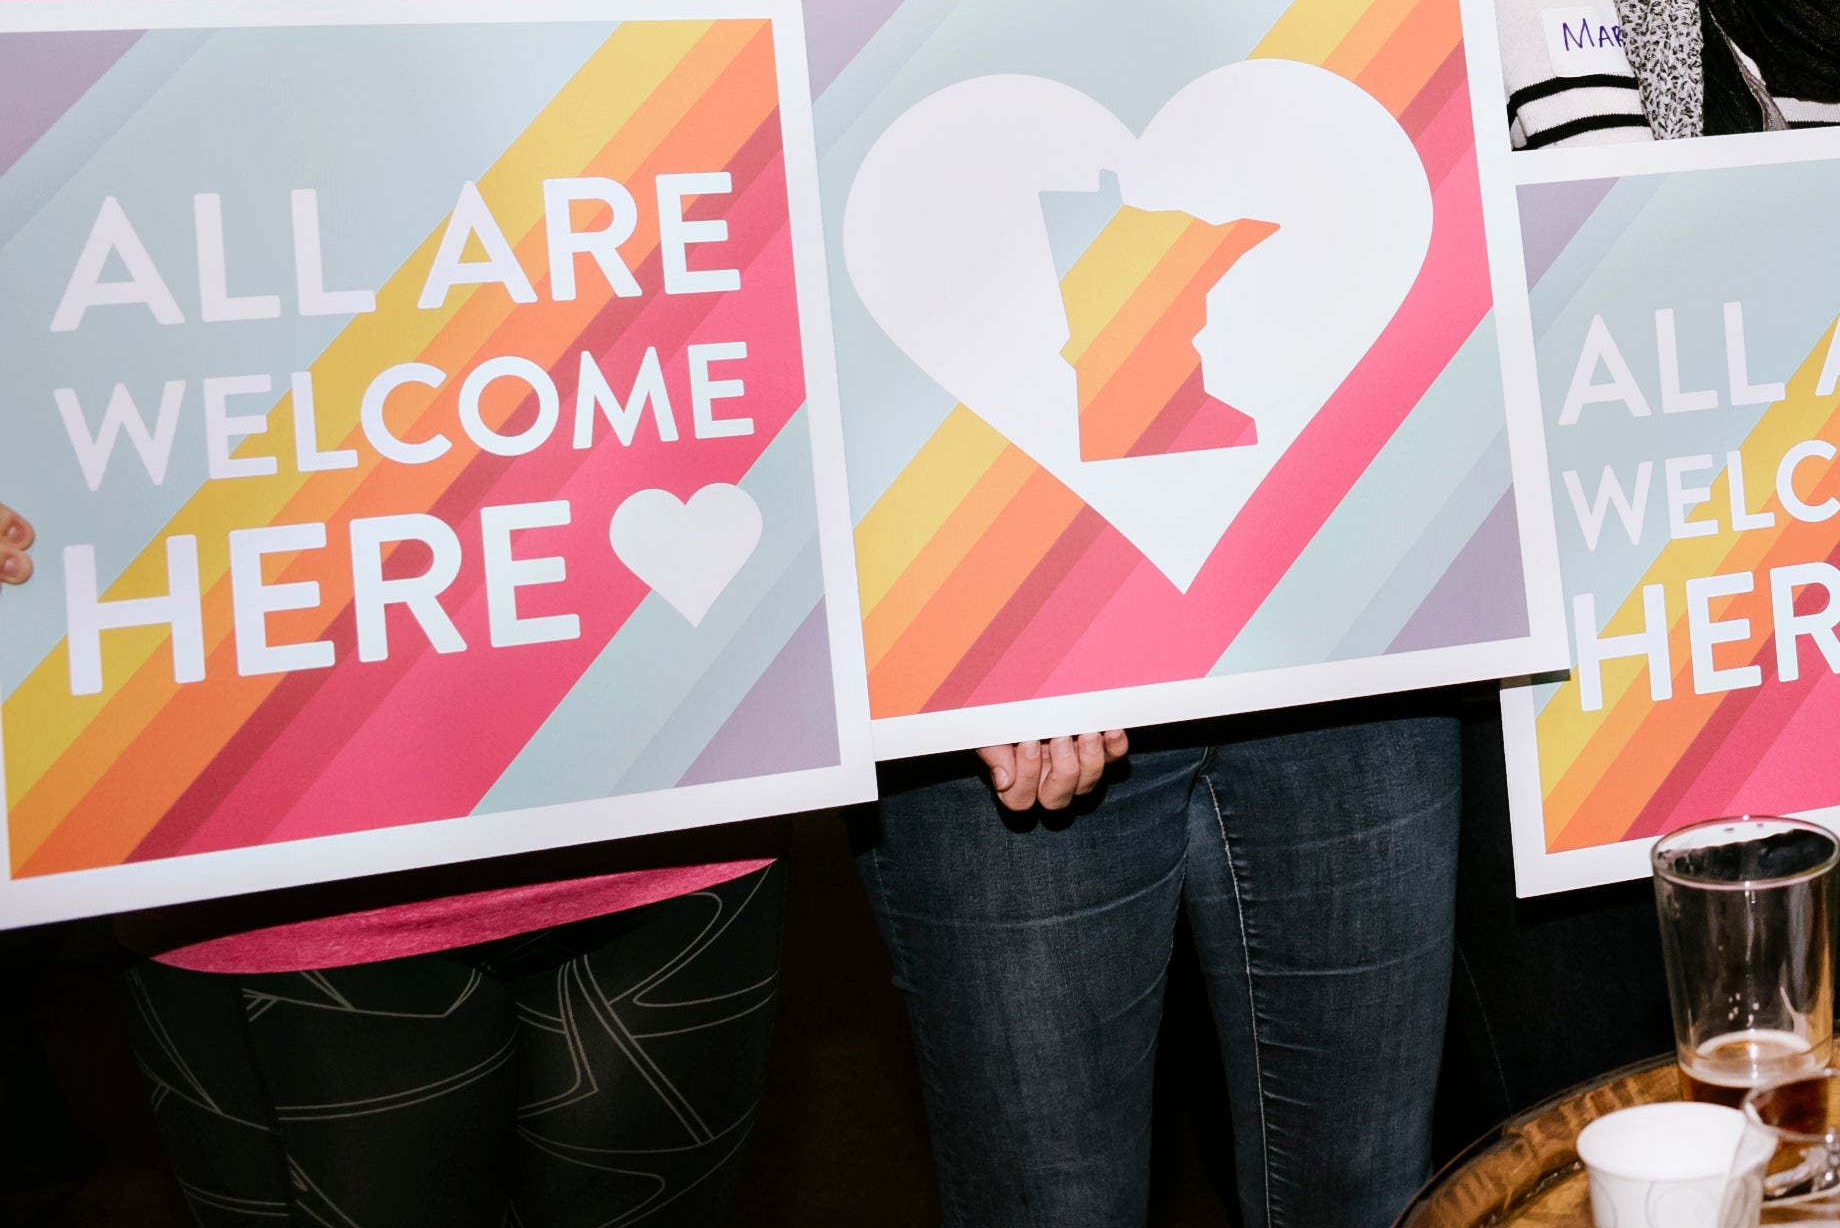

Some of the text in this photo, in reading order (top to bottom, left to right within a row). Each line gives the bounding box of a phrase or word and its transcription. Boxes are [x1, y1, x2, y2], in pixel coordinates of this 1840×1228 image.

[49, 171, 743, 332] ALL ARE
[53, 341, 755, 491] WELCOME
[1558, 301, 1786, 426] ALL
[62, 499, 582, 696] HERE
